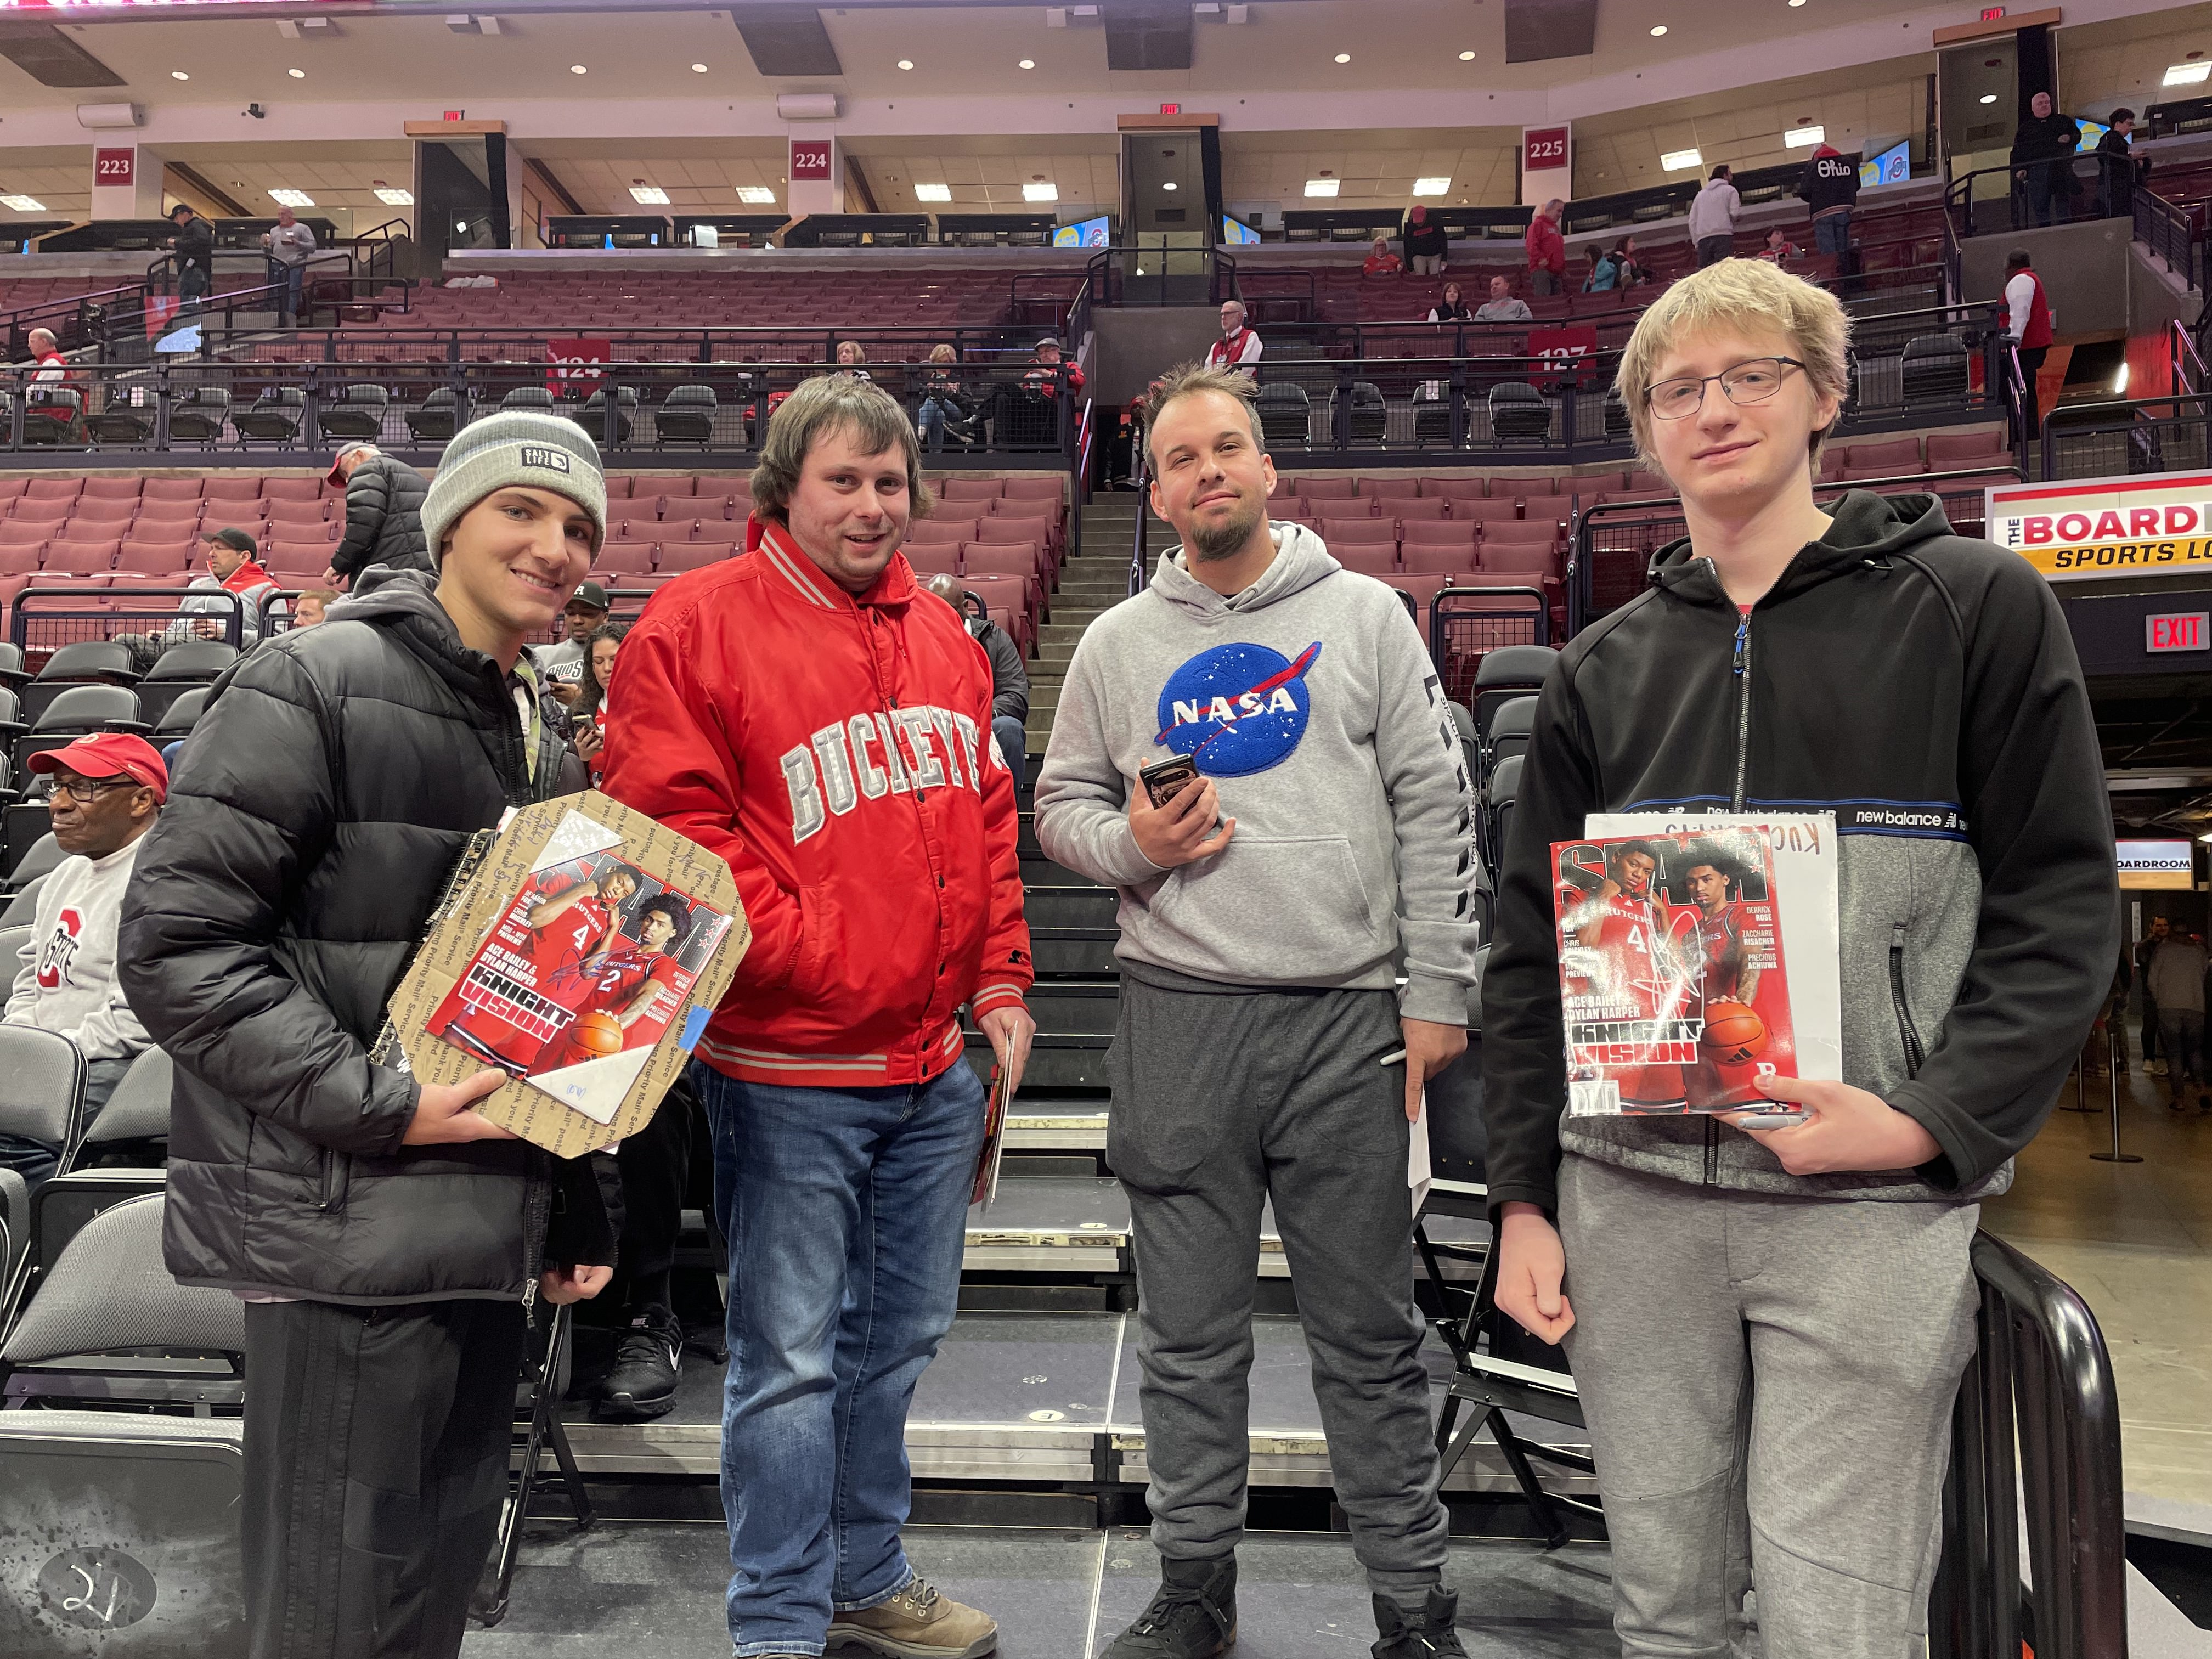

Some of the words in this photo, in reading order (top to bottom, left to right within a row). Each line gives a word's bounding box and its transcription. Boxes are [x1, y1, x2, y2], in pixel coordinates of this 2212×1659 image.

[1530, 140, 1563, 159] 225
[100, 160, 129, 174] 223
[795, 153, 827, 167] 224
[1818, 159, 1851, 178] Ohio
[557, 356, 601, 378] 124
[1538, 346, 1588, 371] 127
[525, 449, 549, 458] SALT
[526, 456, 549, 466] LIFE
[2008, 518, 2021, 545] THE
[2024, 505, 2198, 545] BOARD
[2055, 543, 2175, 568] SPORTS
[2153, 617, 2202, 648] EXIT
[1171, 687, 1299, 727] NASA
[1885, 810, 1942, 827] balance
[2117, 860, 2191, 868] OARDROOM
[520, 895, 531, 904] FOX
[509, 911, 533, 929] BRICKLEY
[513, 906, 527, 918] CHRIS
[572, 900, 603, 933] RUTGERS
[1756, 913, 1772, 922] ROSE
[465, 927, 483, 959] Priority
[496, 929, 522, 946] PREVIEWS
[572, 925, 590, 951] 4
[1564, 939, 1580, 947] CHRIS
[1627, 924, 1647, 954] 4
[1742, 929, 1774, 938] ZACCHARIE
[1743, 937, 1775, 946] RISACHER
[444, 934, 461, 966] Service
[486, 942, 504, 958] ACE
[501, 950, 531, 972] BAILEY
[1747, 953, 1776, 962] PRECIOUS
[419, 946, 437, 979] Priority
[479, 951, 507, 973] DYLAN
[505, 964, 538, 988] HARPER
[1748, 960, 1778, 969] ACHIUWA
[597, 970, 621, 992] 2
[673, 970, 691, 984] DERRICK
[675, 979, 688, 990] ROSE
[468, 962, 577, 1029] KNIGHT
[654, 991, 678, 1007] RISACHER
[397, 1002, 415, 1036] Service
[419, 995, 438, 1028] Priority
[458, 979, 557, 1043] VISION
[645, 1009, 667, 1025] ACHIUWA
[649, 1004, 670, 1019] PRECIOUS
[1601, 1006, 1640, 1019] HARPER
[662, 1046, 678, 1078] Service
[1572, 1041, 1698, 1067] VISION
[639, 1058, 656, 1090] Priority
